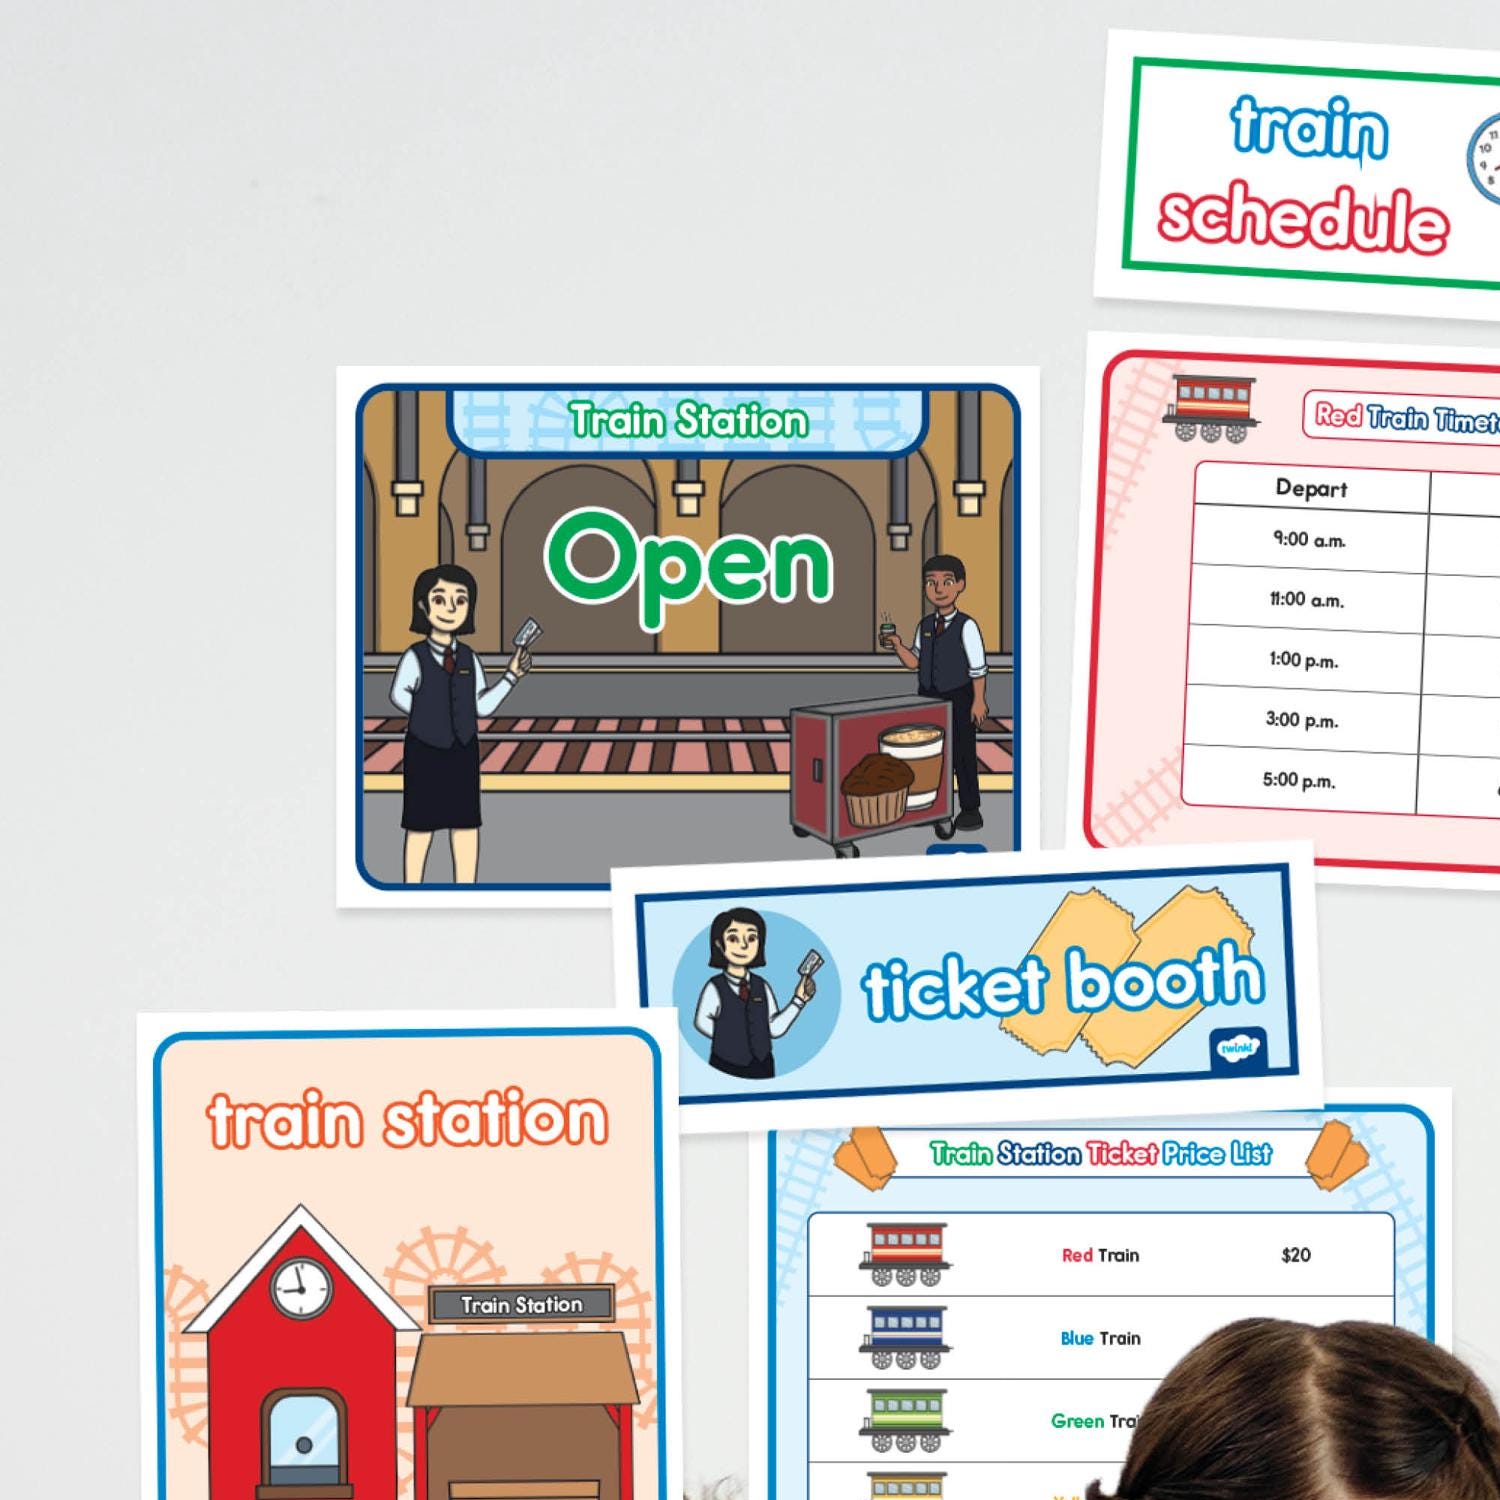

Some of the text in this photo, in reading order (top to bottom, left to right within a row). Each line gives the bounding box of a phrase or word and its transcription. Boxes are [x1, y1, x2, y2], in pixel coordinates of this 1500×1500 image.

[1230, 93, 1389, 170] train
[1490, 131, 1498, 139] 11
[1480, 144, 1492, 153] 10
[1480, 161, 1487, 170] 9
[1488, 176, 1494, 185] 8
[1157, 178, 1451, 257] schedule
[567, 400, 810, 440] Train Station
[1315, 402, 1363, 428] Red
[1366, 404, 1429, 431] Train
[1277, 477, 1348, 502] Depart
[1274, 530, 1346, 547] 9:00 a.m.
[543, 505, 835, 634] Open
[1270, 591, 1344, 608] 11:00 a.m.
[1270, 651, 1338, 672] 1:00 p.m.
[1266, 711, 1338, 731] 3:00 p.m.
[1263, 772, 1335, 792] 5:00 p.m.
[860, 938, 1266, 1023] ticket booth
[1222, 1043, 1252, 1053] twinkl
[205, 1085, 609, 1151] train station
[930, 1140, 1273, 1166] Train Station Ticket Price List
[1063, 1247, 1139, 1262] Red Train
[1282, 1247, 1311, 1263] $20
[462, 1297, 582, 1314] Train Station
[1062, 1330, 1141, 1345] Blue Train
[1051, 1413, 1139, 1429] Green Tra
